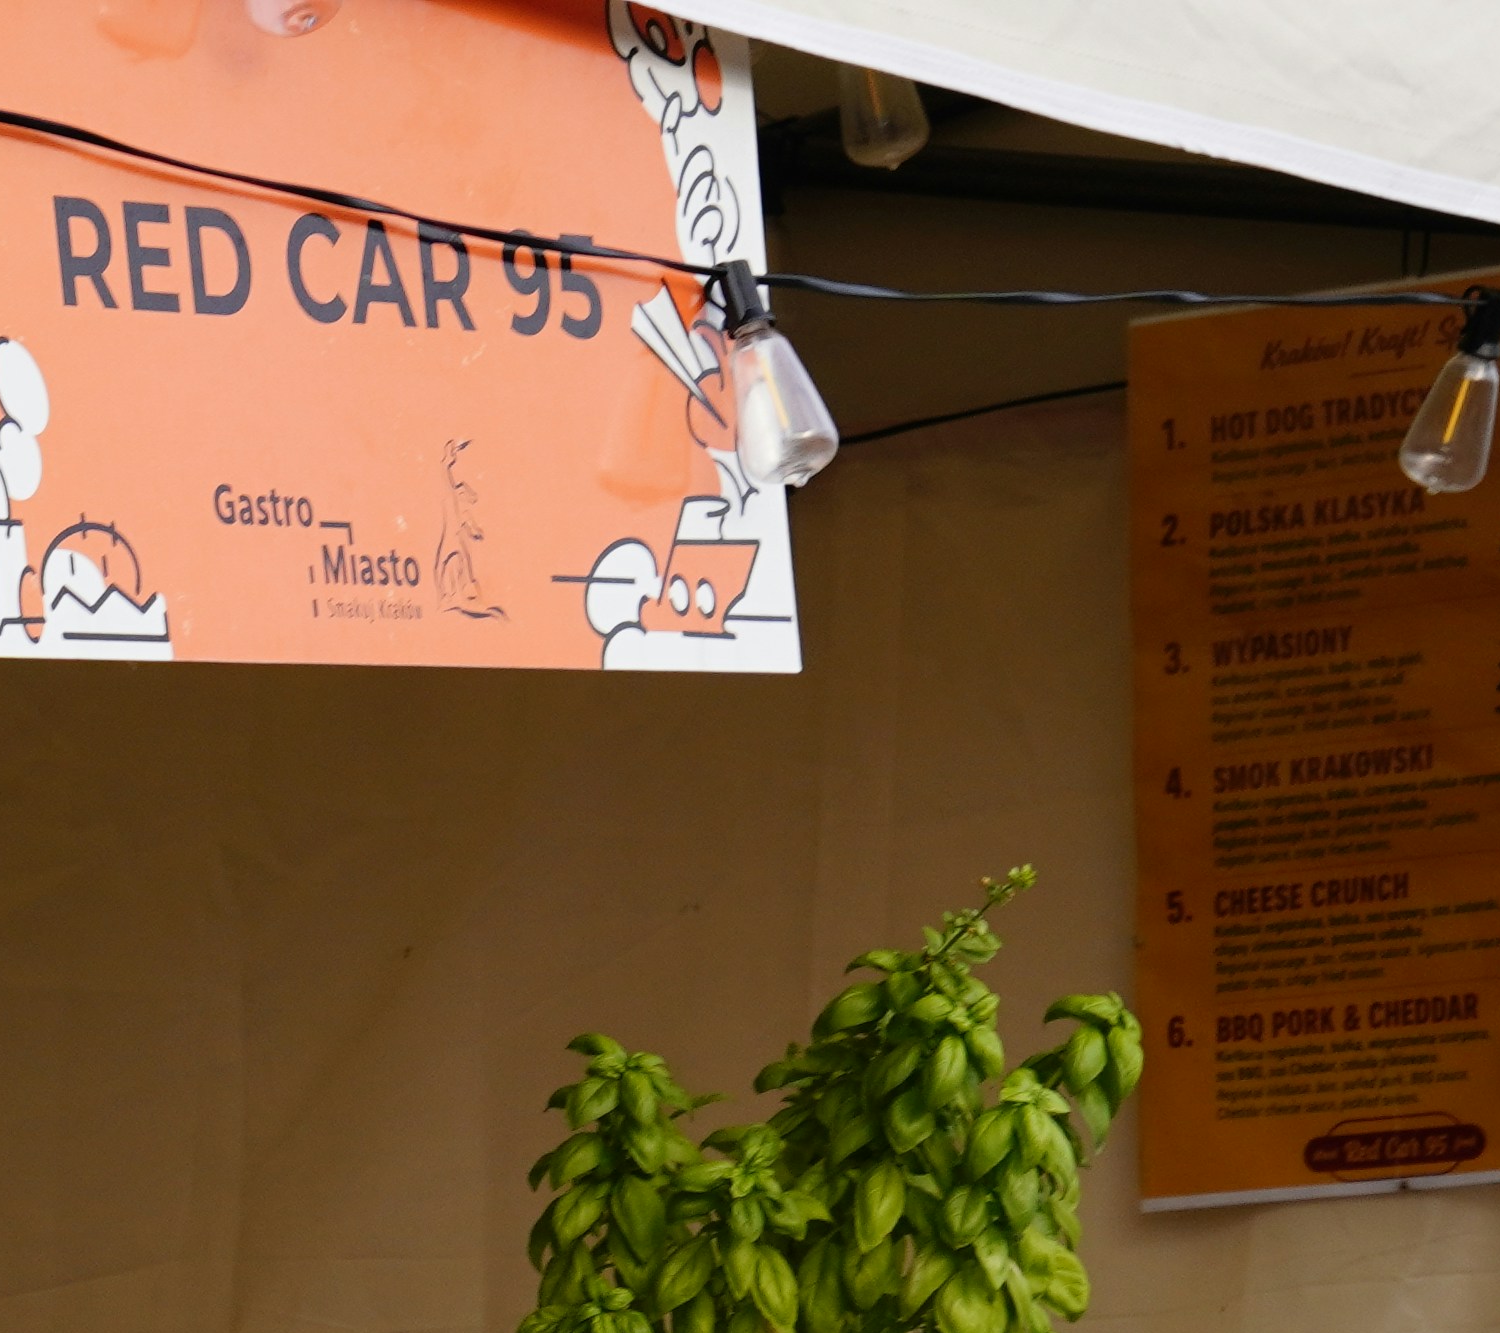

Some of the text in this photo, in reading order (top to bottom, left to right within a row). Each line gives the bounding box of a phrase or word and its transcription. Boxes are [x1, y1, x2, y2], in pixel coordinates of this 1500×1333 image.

[54, 195, 602, 340] RED CAR 95
[1162, 419, 1187, 451] 1.
[1210, 411, 1258, 443] HOT
[1264, 402, 1314, 435] DOG
[213, 484, 314, 528] Gastro
[1160, 487, 1428, 548] 2. POLSKA KLASYKA
[322, 544, 421, 588] Miasto
[1163, 625, 1354, 676] 3. WYPASIONY
[1164, 743, 1435, 801] 4. SMOK KRAKOWSKI
[1165, 872, 1412, 925] 5. CHEESE CRUNCH
[1167, 992, 1481, 1050] 6. BBQ PORK & CHEDDAR
